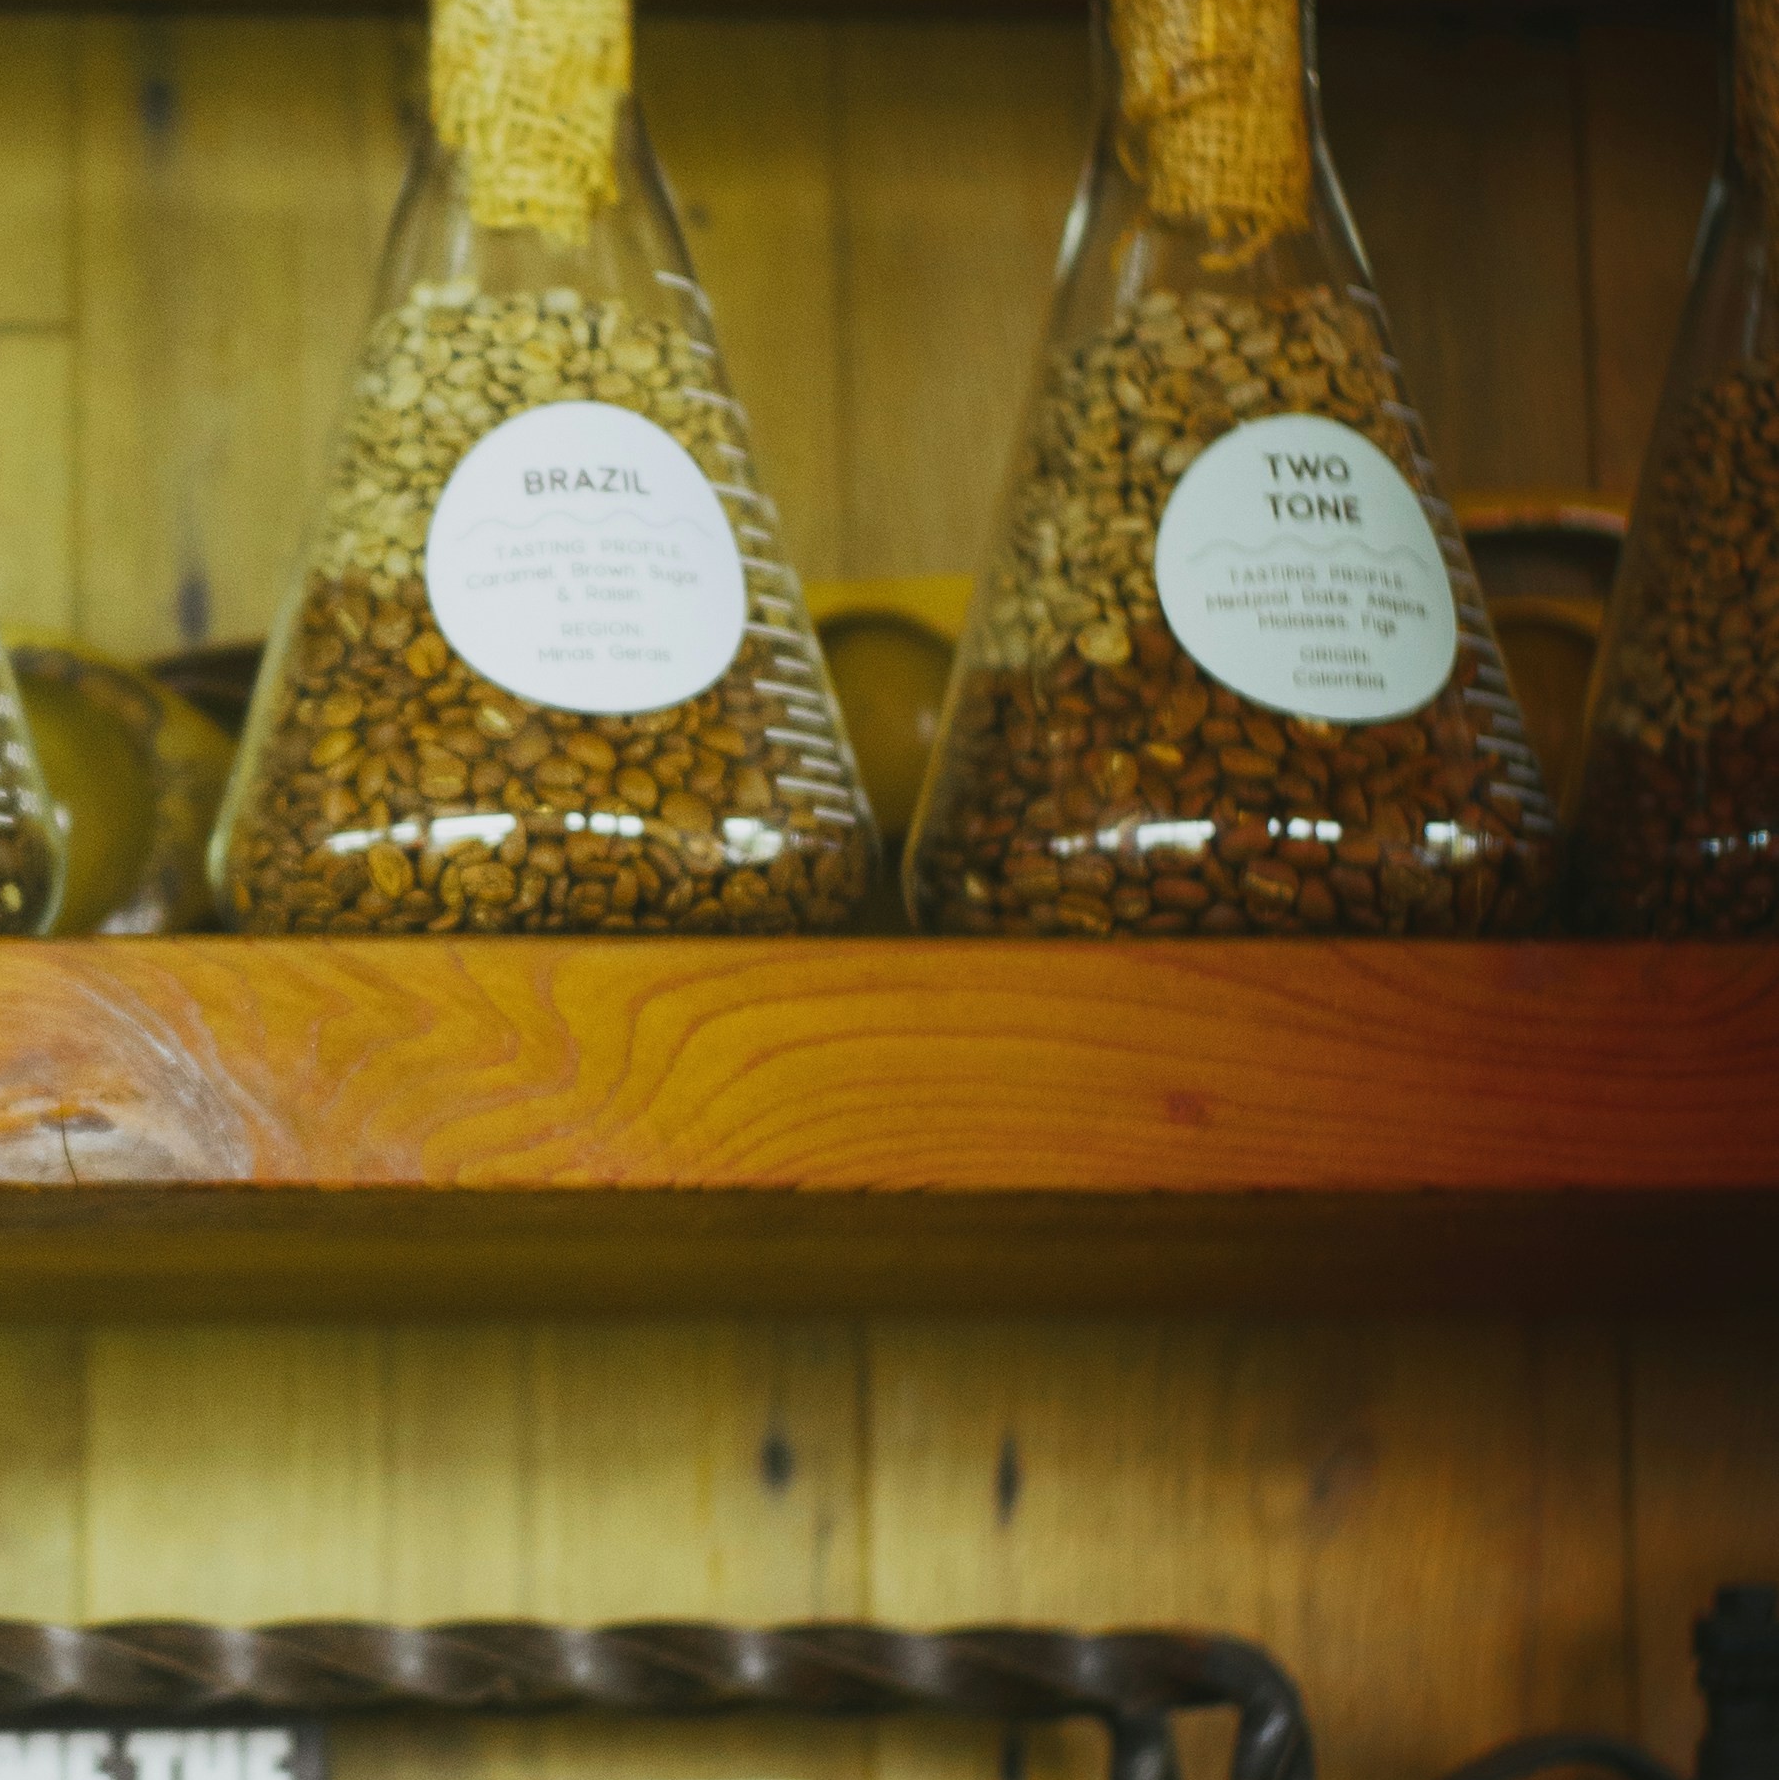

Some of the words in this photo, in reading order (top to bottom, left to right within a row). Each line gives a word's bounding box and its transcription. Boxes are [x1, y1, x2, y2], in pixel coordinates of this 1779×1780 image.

[1264, 452, 1351, 485] TWO
[523, 467, 651, 496] BRAZIL
[1267, 493, 1362, 526] TONE
[494, 538, 586, 560] TASTING
[570, 561, 635, 578] Brown
[1229, 563, 1317, 585] TASTING
[557, 585, 570, 603] &
[538, 647, 596, 664] Minas
[608, 646, 672, 664] Gerais
